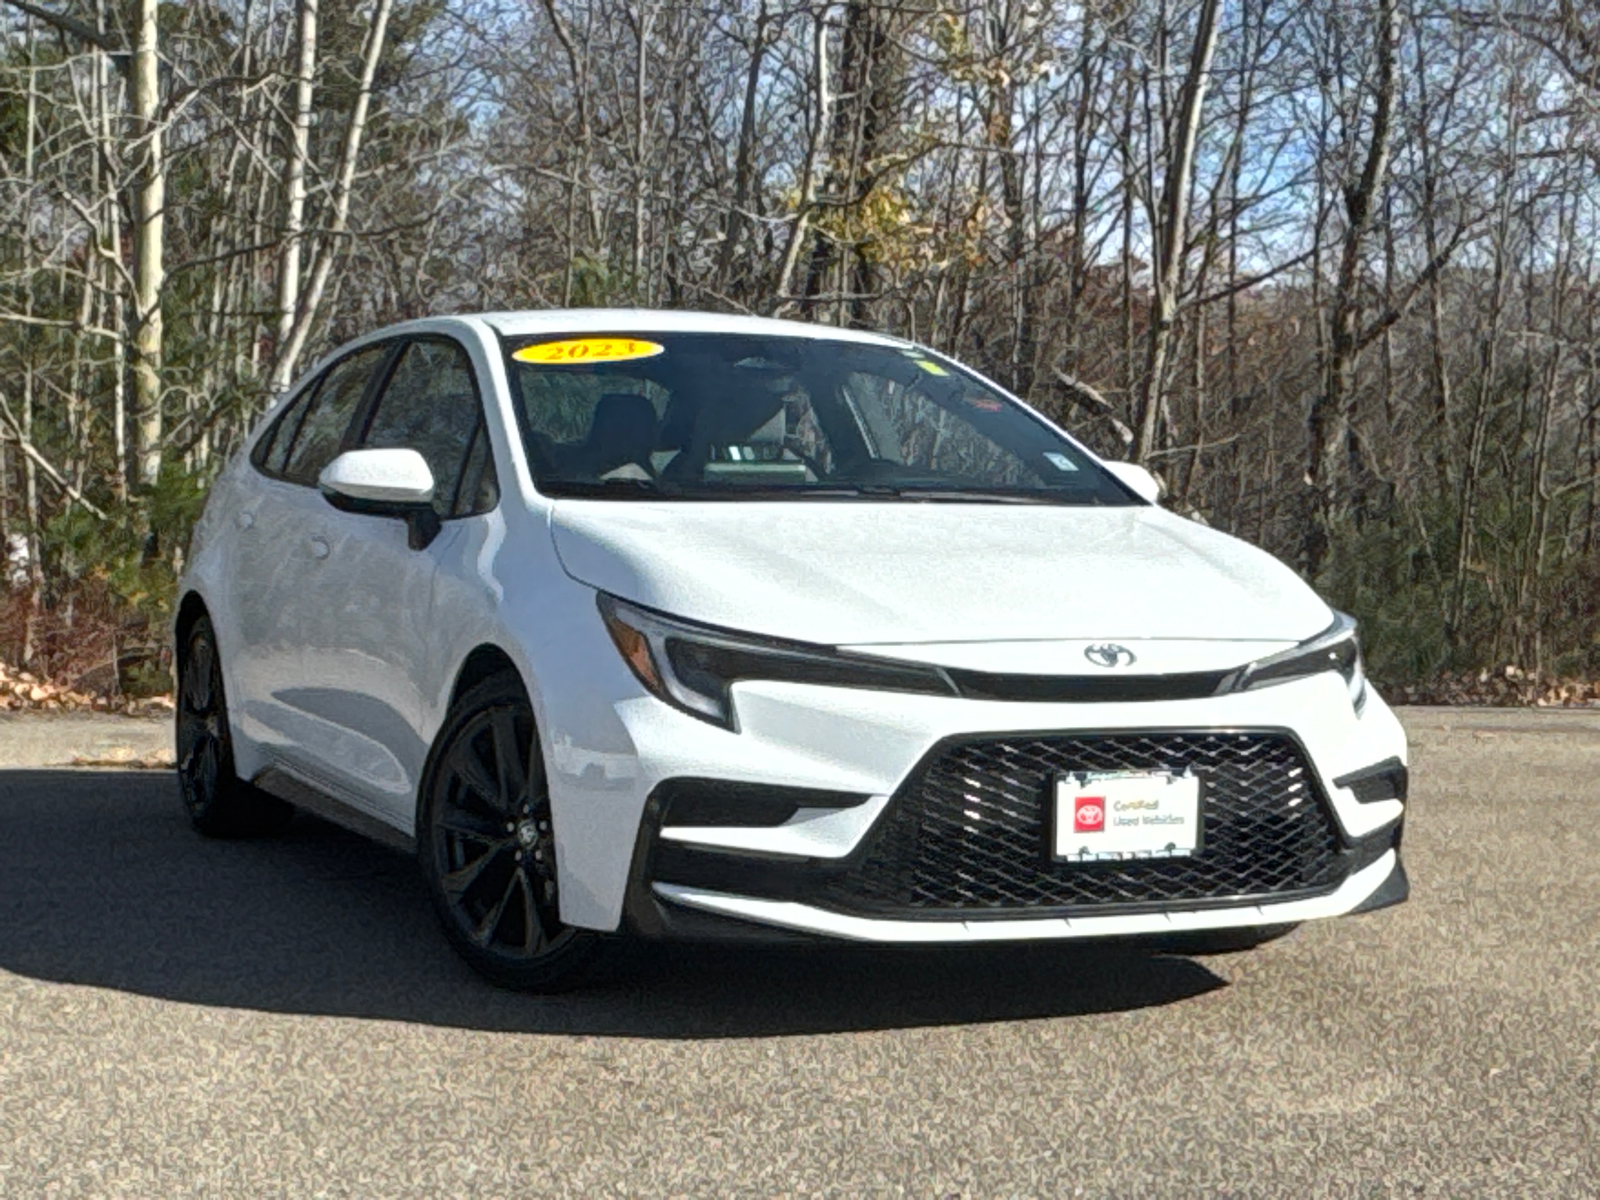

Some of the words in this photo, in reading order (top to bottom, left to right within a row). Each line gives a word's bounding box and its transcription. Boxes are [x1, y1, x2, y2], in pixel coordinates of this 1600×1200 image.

[545, 342, 636, 360] 2023
[1113, 799, 1159, 812] Certified
[1113, 816, 1139, 826] Used
[1142, 814, 1184, 825] Vehicles
